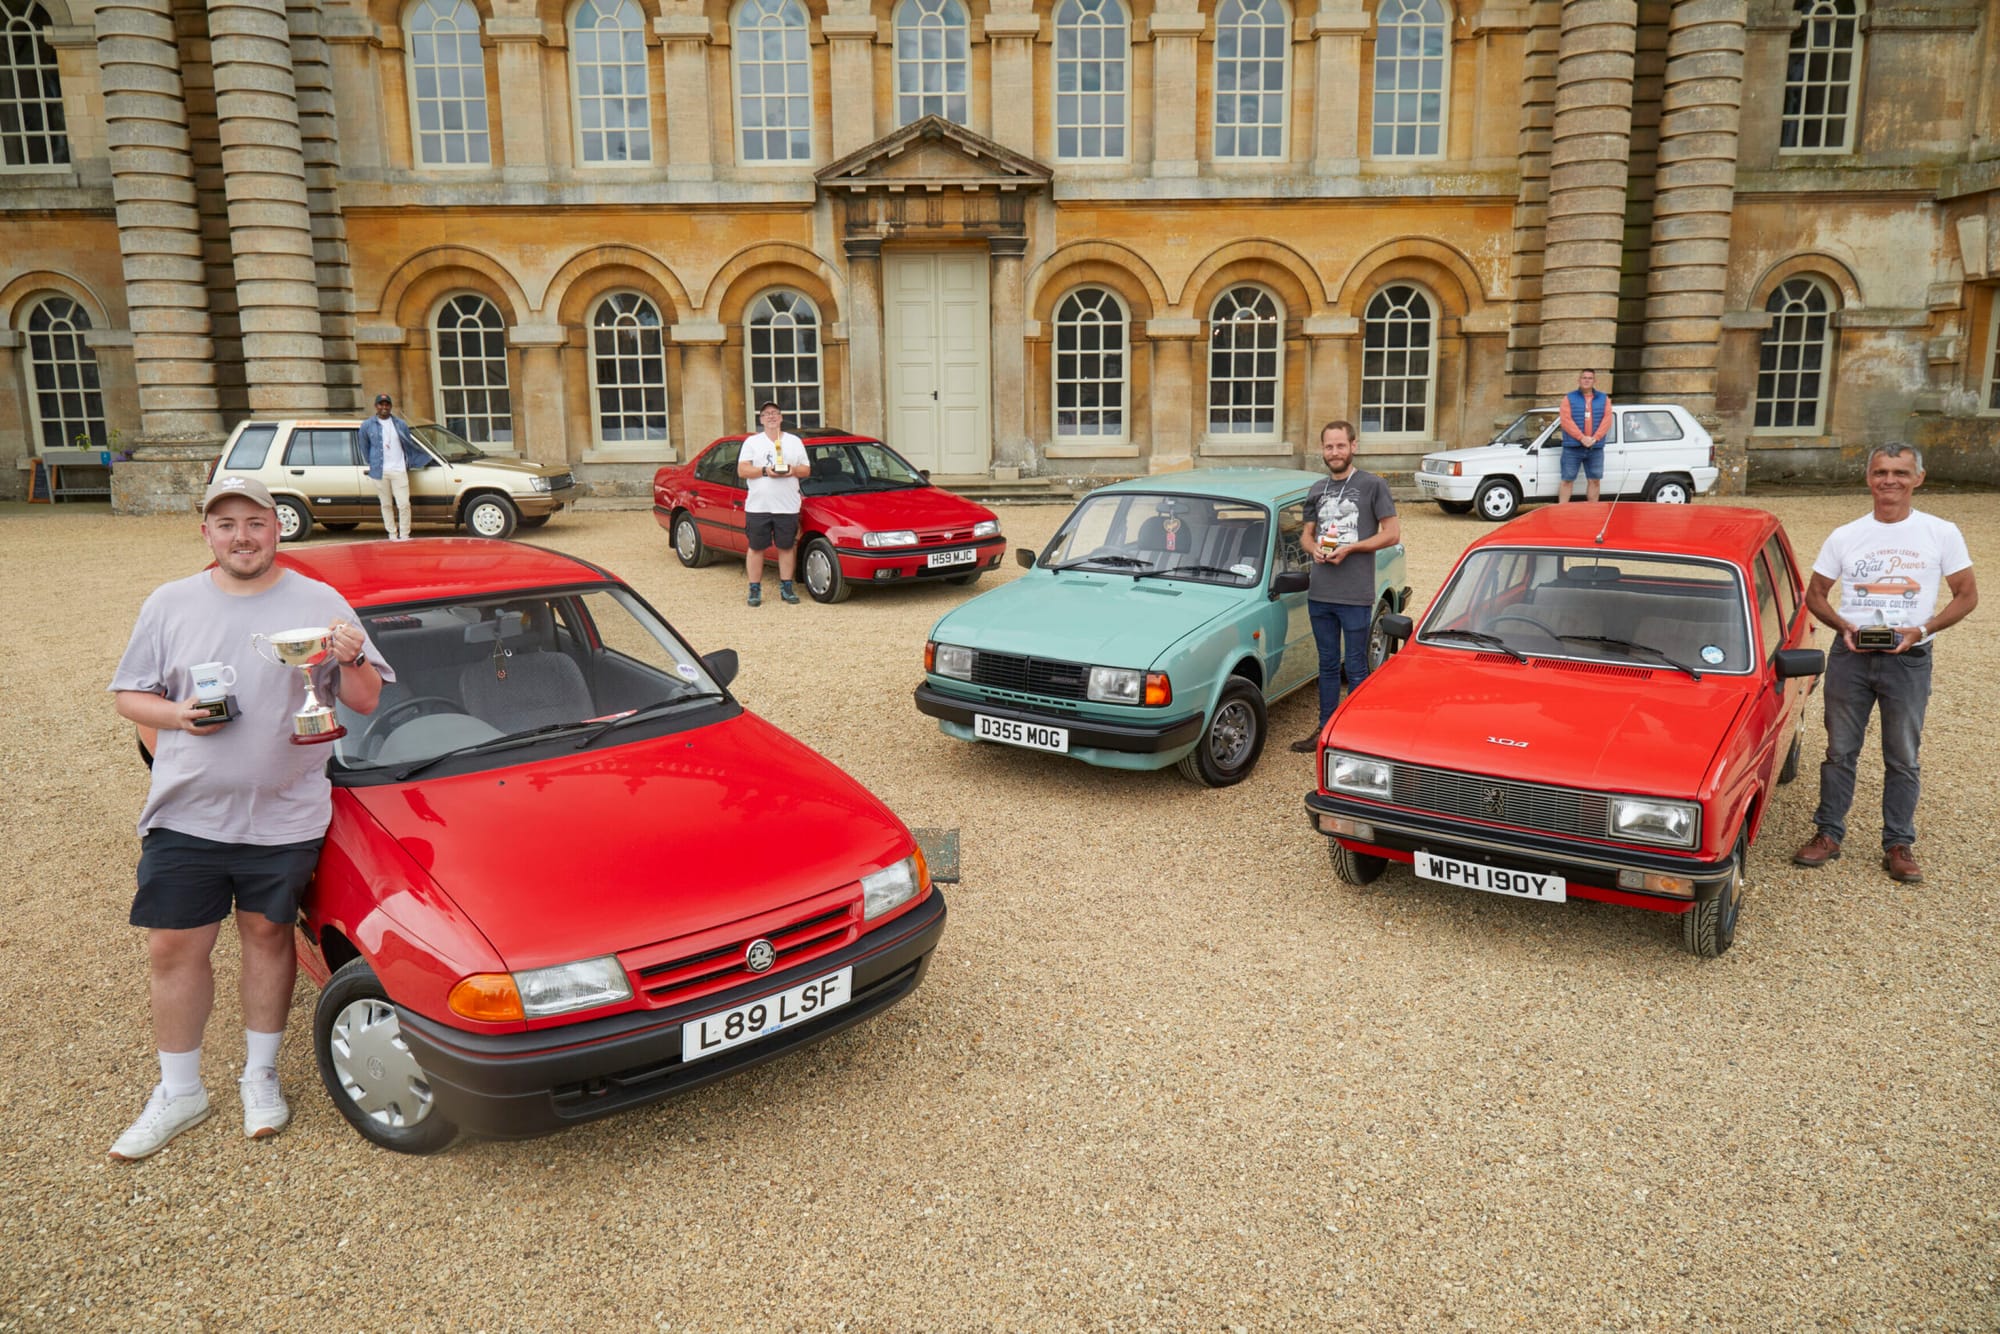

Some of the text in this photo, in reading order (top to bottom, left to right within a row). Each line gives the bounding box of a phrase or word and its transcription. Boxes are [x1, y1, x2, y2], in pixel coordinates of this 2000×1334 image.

[932, 550, 972, 565] H59 MJC
[1851, 555, 1927, 578] Real Power
[1863, 599, 1887, 608] SCHOOL
[1889, 599, 1918, 609] CULTURE
[981, 717, 1060, 748] D355 MOG
[1486, 735, 1529, 748] 104
[1429, 857, 1548, 896] WPH 190Y
[700, 975, 839, 1050] L89 LSF
